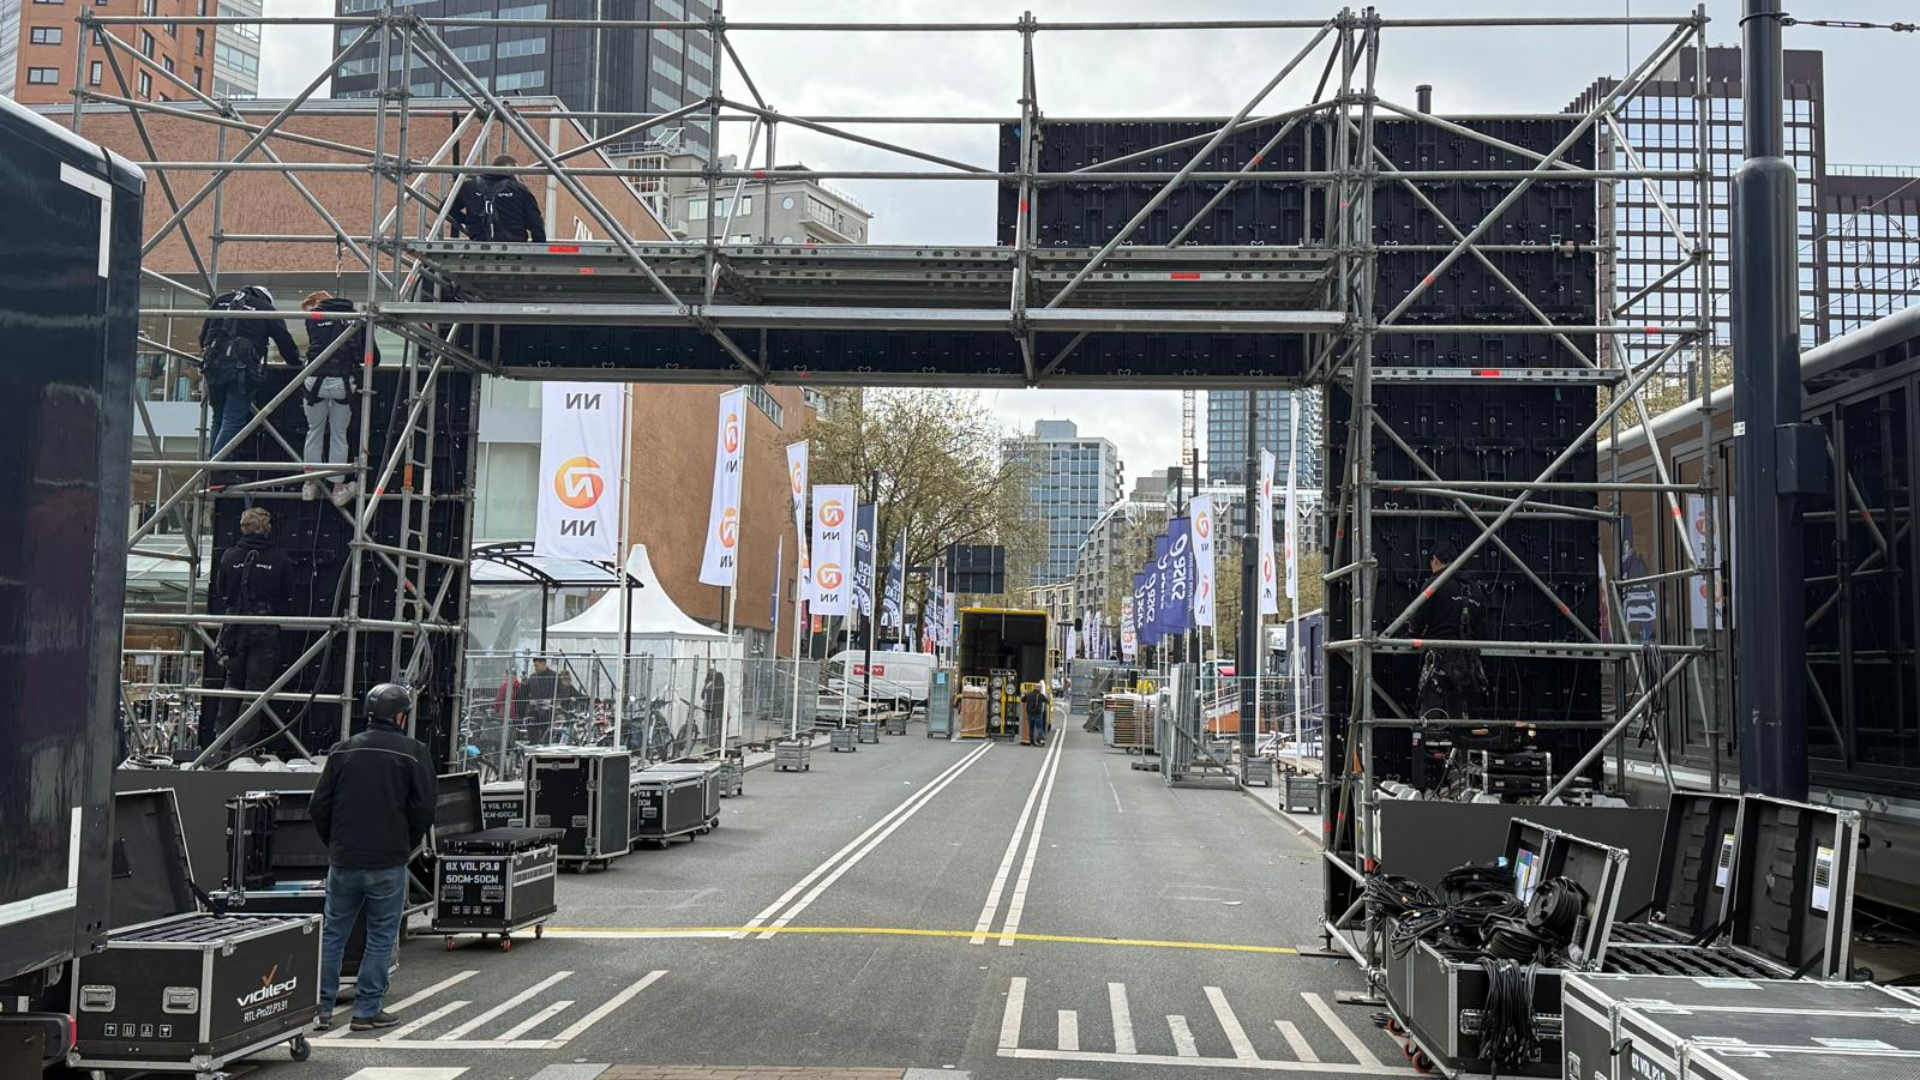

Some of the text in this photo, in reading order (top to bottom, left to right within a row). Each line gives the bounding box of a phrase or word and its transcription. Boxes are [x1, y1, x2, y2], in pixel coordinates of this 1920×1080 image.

[460, 861, 477, 871] VDL
[445, 874, 499, 884] 50CM-50CM
[237, 977, 296, 1006] vidiled
